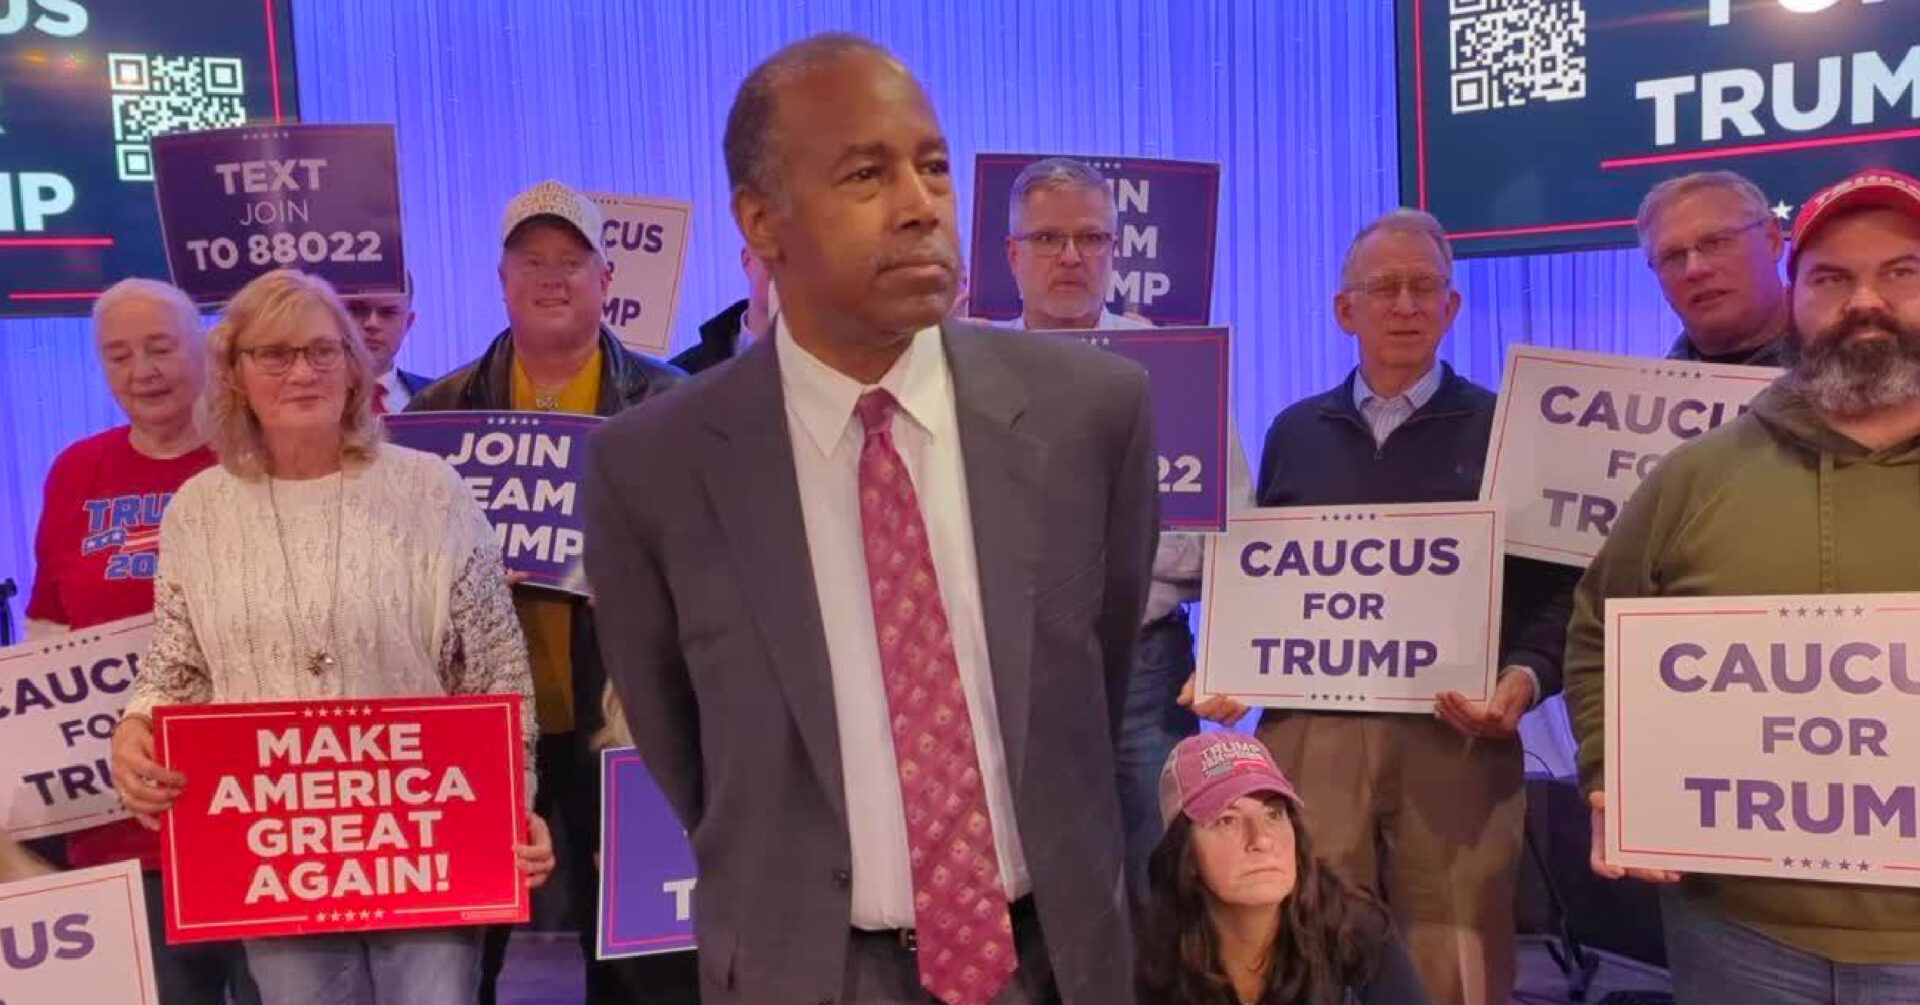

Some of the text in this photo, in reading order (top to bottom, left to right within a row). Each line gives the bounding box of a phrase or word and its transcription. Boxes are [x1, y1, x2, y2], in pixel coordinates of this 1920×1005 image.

[1636, 45, 1920, 146] TRUM
[215, 159, 328, 195] TEXT
[240, 200, 308, 226] JOIN
[187, 231, 383, 271] TO 88022
[602, 218, 664, 253] CUS
[1540, 386, 1751, 440] CAUC
[447, 432, 571, 469] JOIN
[1607, 449, 1663, 481] FO
[82, 493, 174, 532] TRU
[463, 476, 577, 516] EAM
[105, 552, 159, 579] 20
[1240, 538, 1460, 577] CAUCUS
[1303, 593, 1384, 620] FOR
[1251, 639, 1438, 678] TRUMP
[1659, 642, 1920, 695] CAUCU
[59, 708, 125, 747] FO
[257, 723, 423, 767] MAKE
[1762, 717, 1889, 756] FOR
[207, 766, 476, 815] AMERICA
[1684, 777, 1918, 838] TRUM
[247, 810, 443, 856] GREAT
[244, 854, 450, 905] AGAIN!
